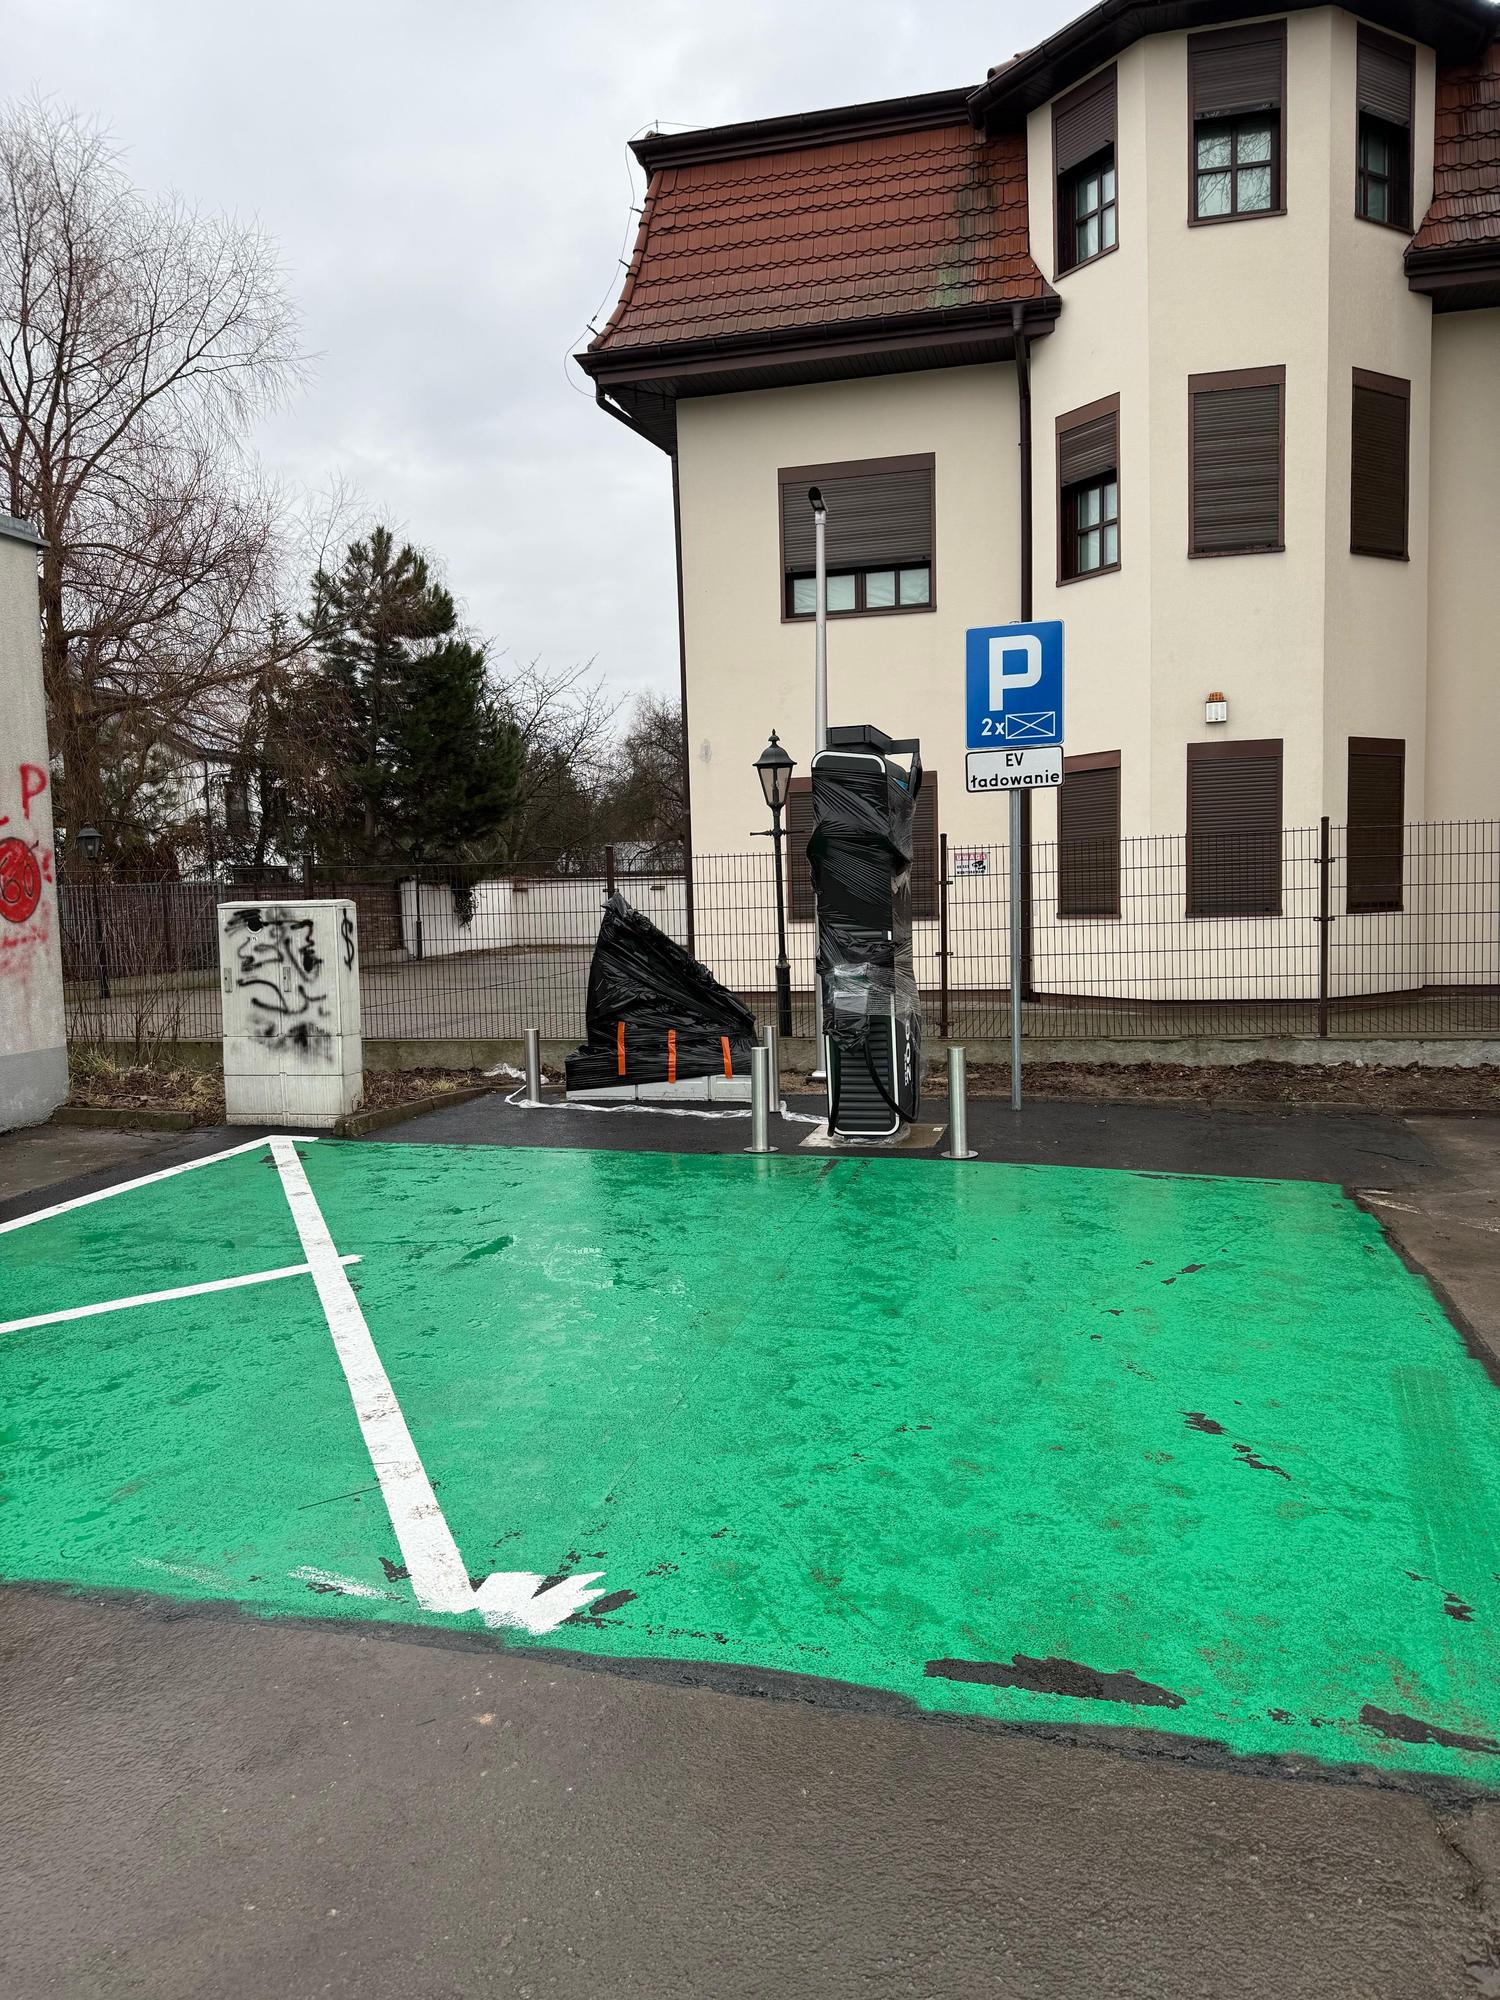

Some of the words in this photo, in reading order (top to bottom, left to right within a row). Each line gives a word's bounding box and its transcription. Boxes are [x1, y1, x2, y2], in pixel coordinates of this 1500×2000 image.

[988, 634, 1043, 712] P
[981, 717, 1006, 736] 2x
[1005, 752, 1024, 767] EV
[970, 769, 1060, 788] ładowanie
